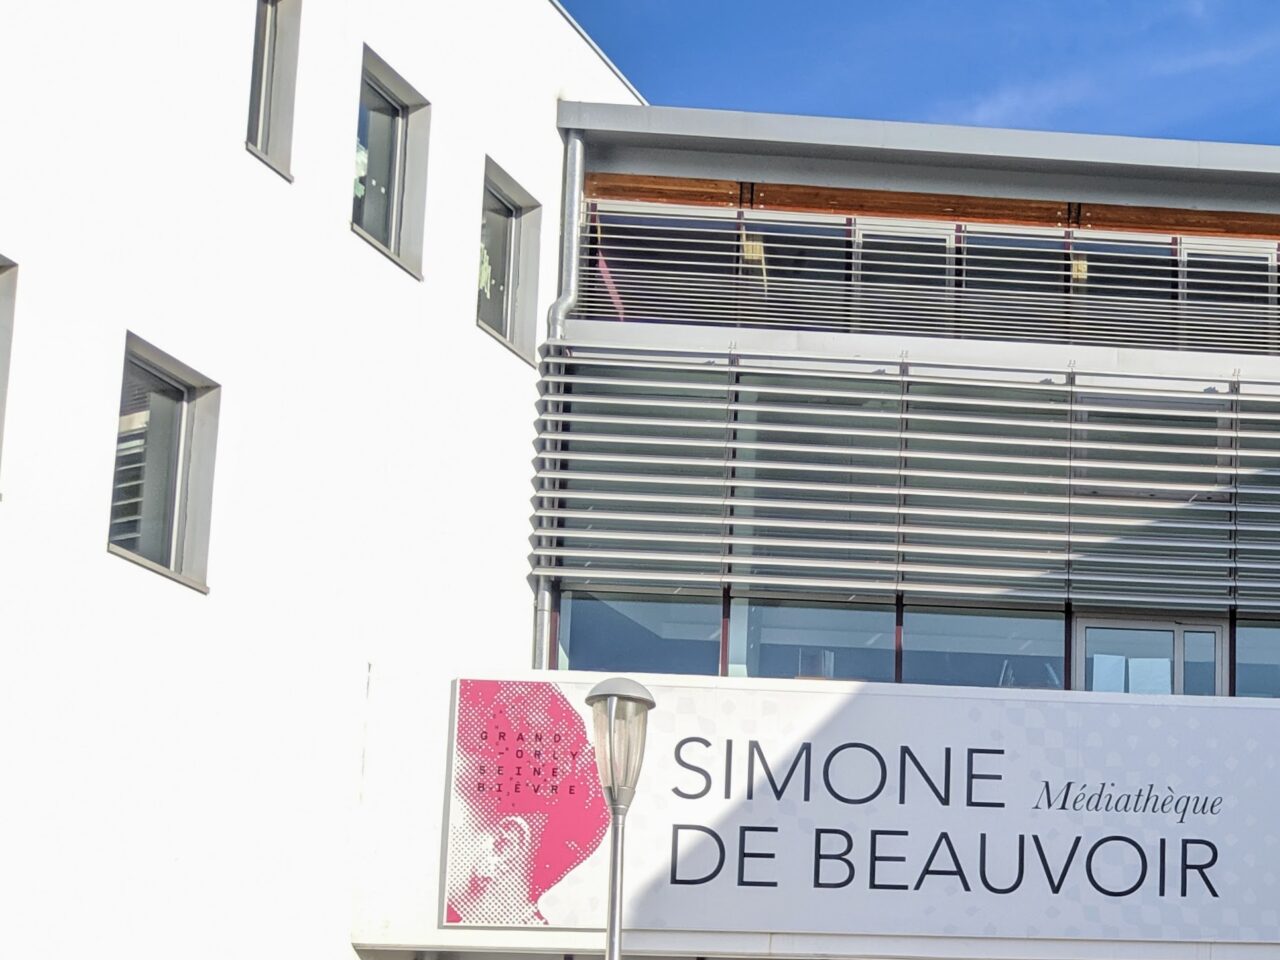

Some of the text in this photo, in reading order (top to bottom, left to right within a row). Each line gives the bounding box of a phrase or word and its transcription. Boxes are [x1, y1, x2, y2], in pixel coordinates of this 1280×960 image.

[480, 731, 561, 743] GRAND
[479, 765, 558, 777] SEINE
[671, 736, 1006, 808] SIMONE
[1031, 780, 1224, 824] Médiathèque
[669, 823, 1220, 898] DE BEAUVOIR
